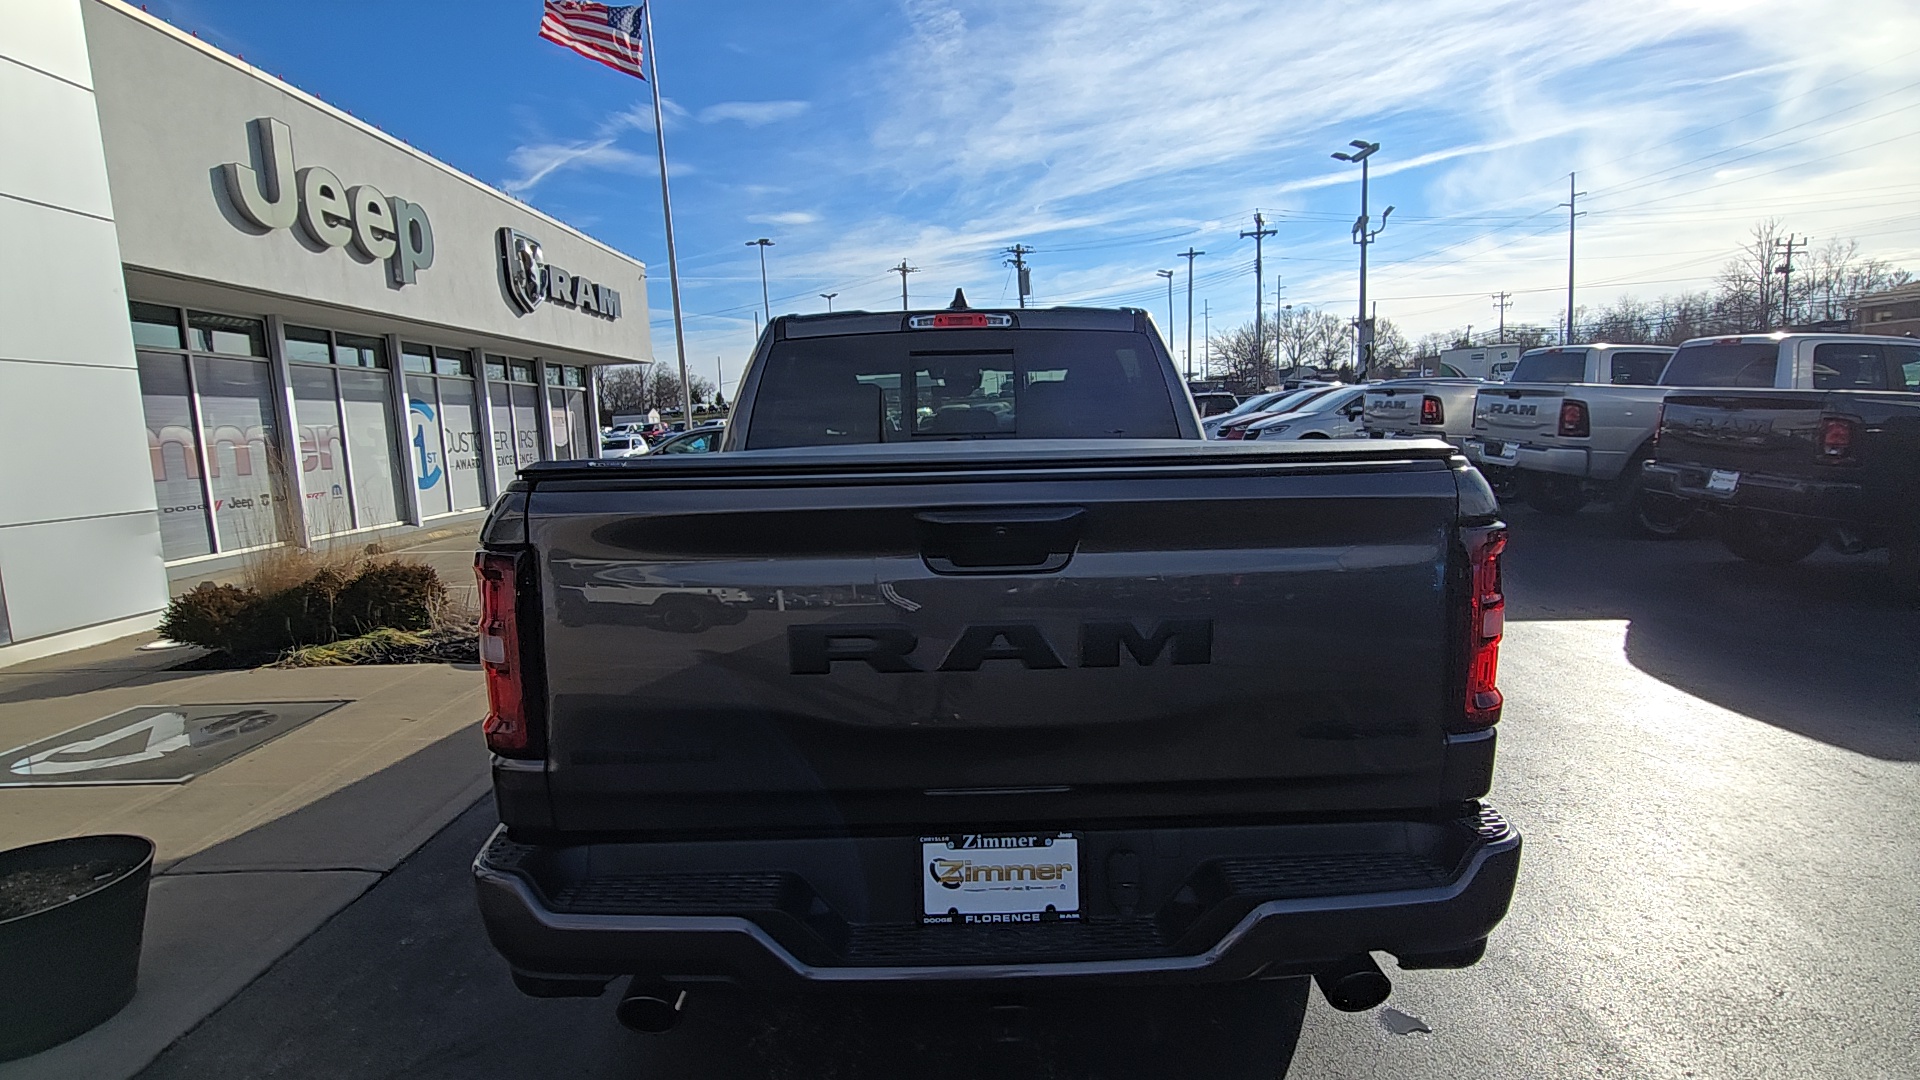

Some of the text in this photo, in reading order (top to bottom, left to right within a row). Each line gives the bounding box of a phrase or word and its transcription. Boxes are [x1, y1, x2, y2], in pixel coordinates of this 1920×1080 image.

[230, 117, 434, 285] Jeep
[547, 264, 623, 319] RAM
[1373, 400, 1407, 409] RAM
[1490, 403, 1538, 416] RAM
[455, 453, 534, 471] AWARD EXCEENCE
[163, 504, 208, 514] DODG
[228, 497, 254, 510] Jeep
[787, 618, 1214, 674] RAM
[962, 834, 1038, 849] Zimmer
[938, 859, 1073, 883] Zimmer
[923, 916, 953, 924] DODGE
[965, 913, 1041, 924] FLORENCE
